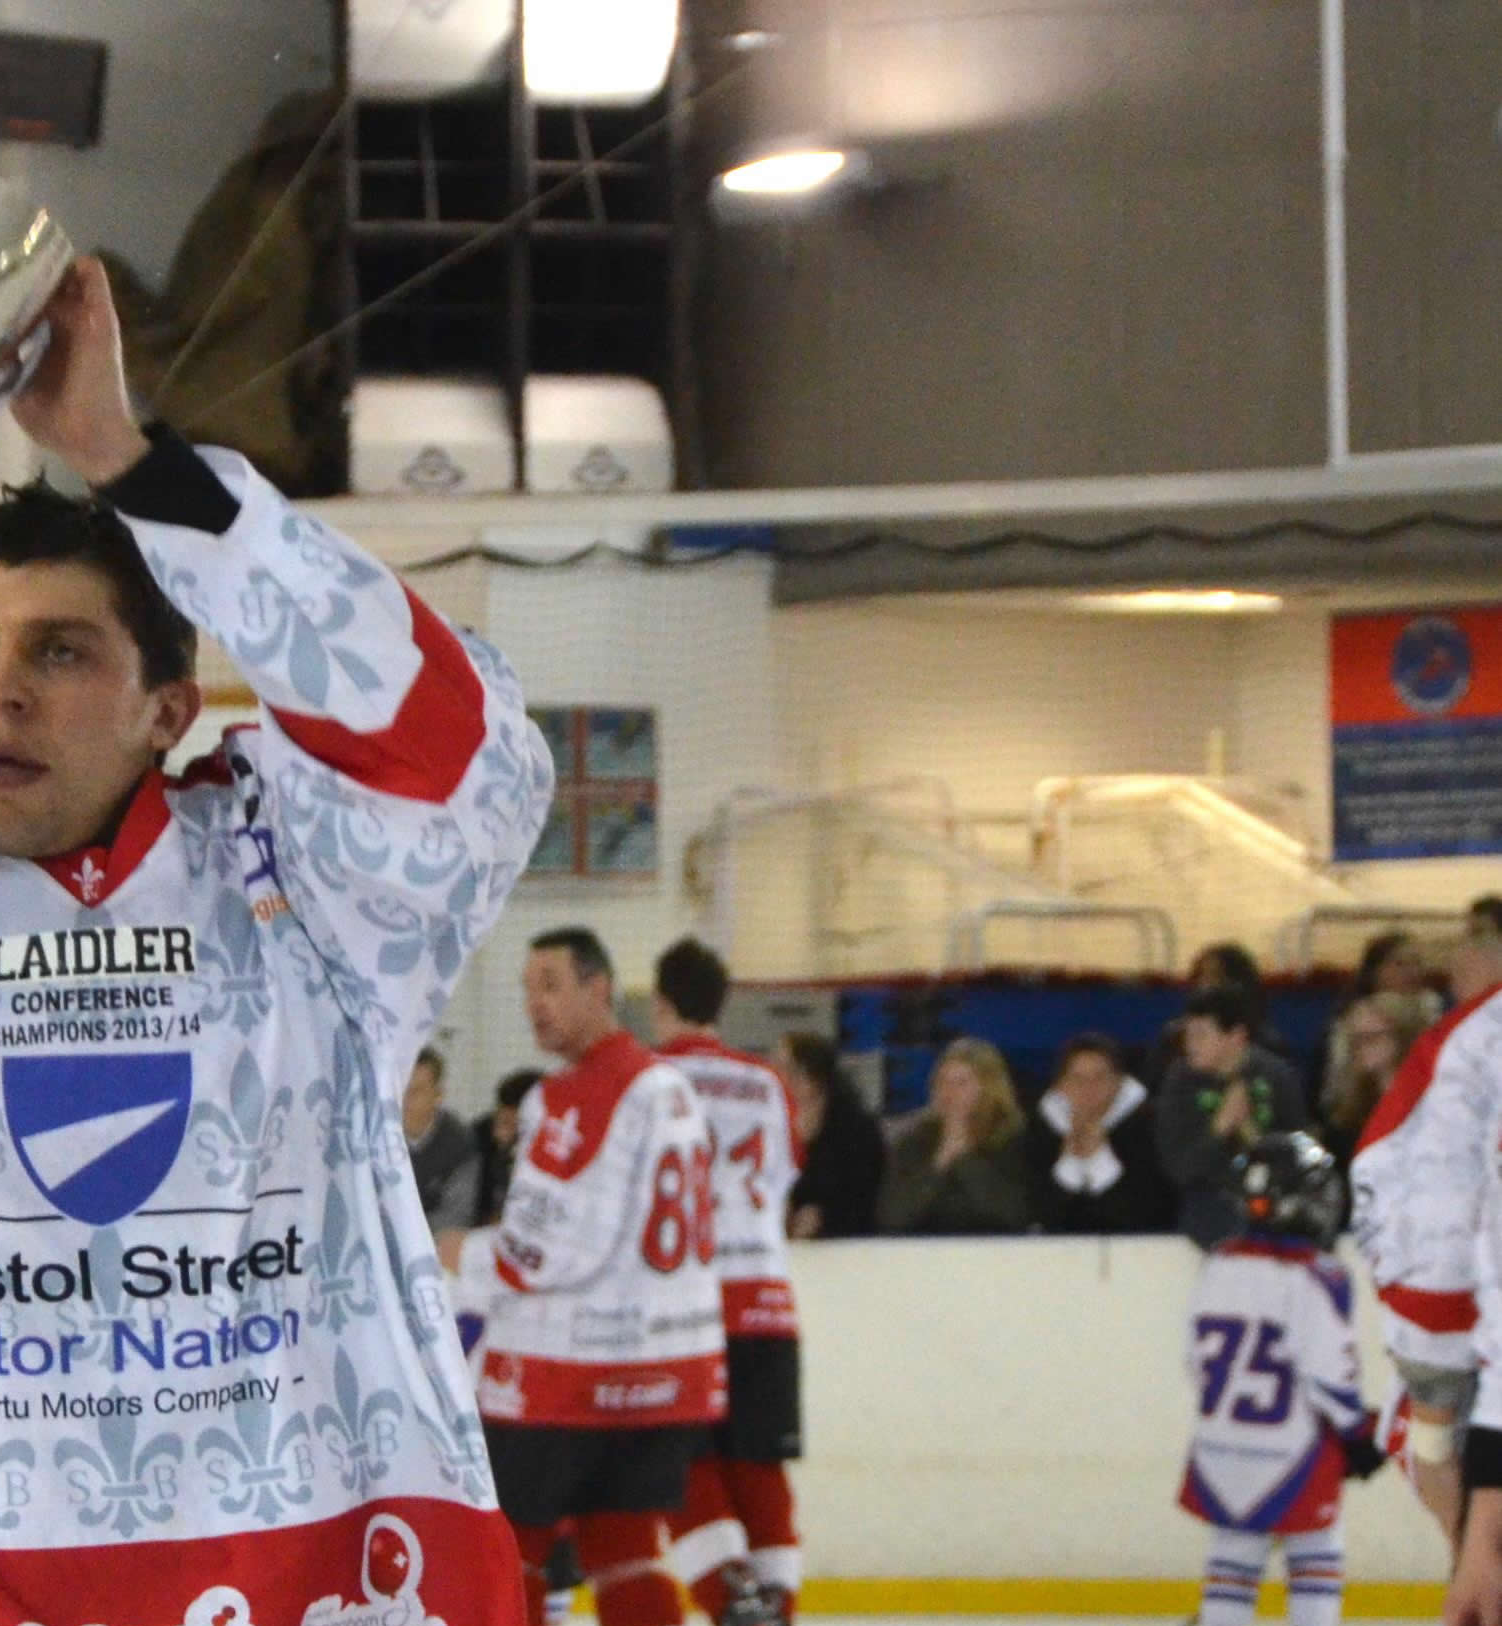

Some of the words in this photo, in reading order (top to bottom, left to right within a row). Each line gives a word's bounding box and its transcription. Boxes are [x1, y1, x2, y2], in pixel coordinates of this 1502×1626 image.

[10, 985, 175, 1015] CONFERENCE
[111, 1012, 202, 1042] 2013/14
[120, 1224, 304, 1300] Street
[111, 1308, 300, 1374] Nation
[41, 1393, 144, 1419] Motors
[153, 1374, 282, 1414] Company
[1194, 1315, 1295, 1426] 75
